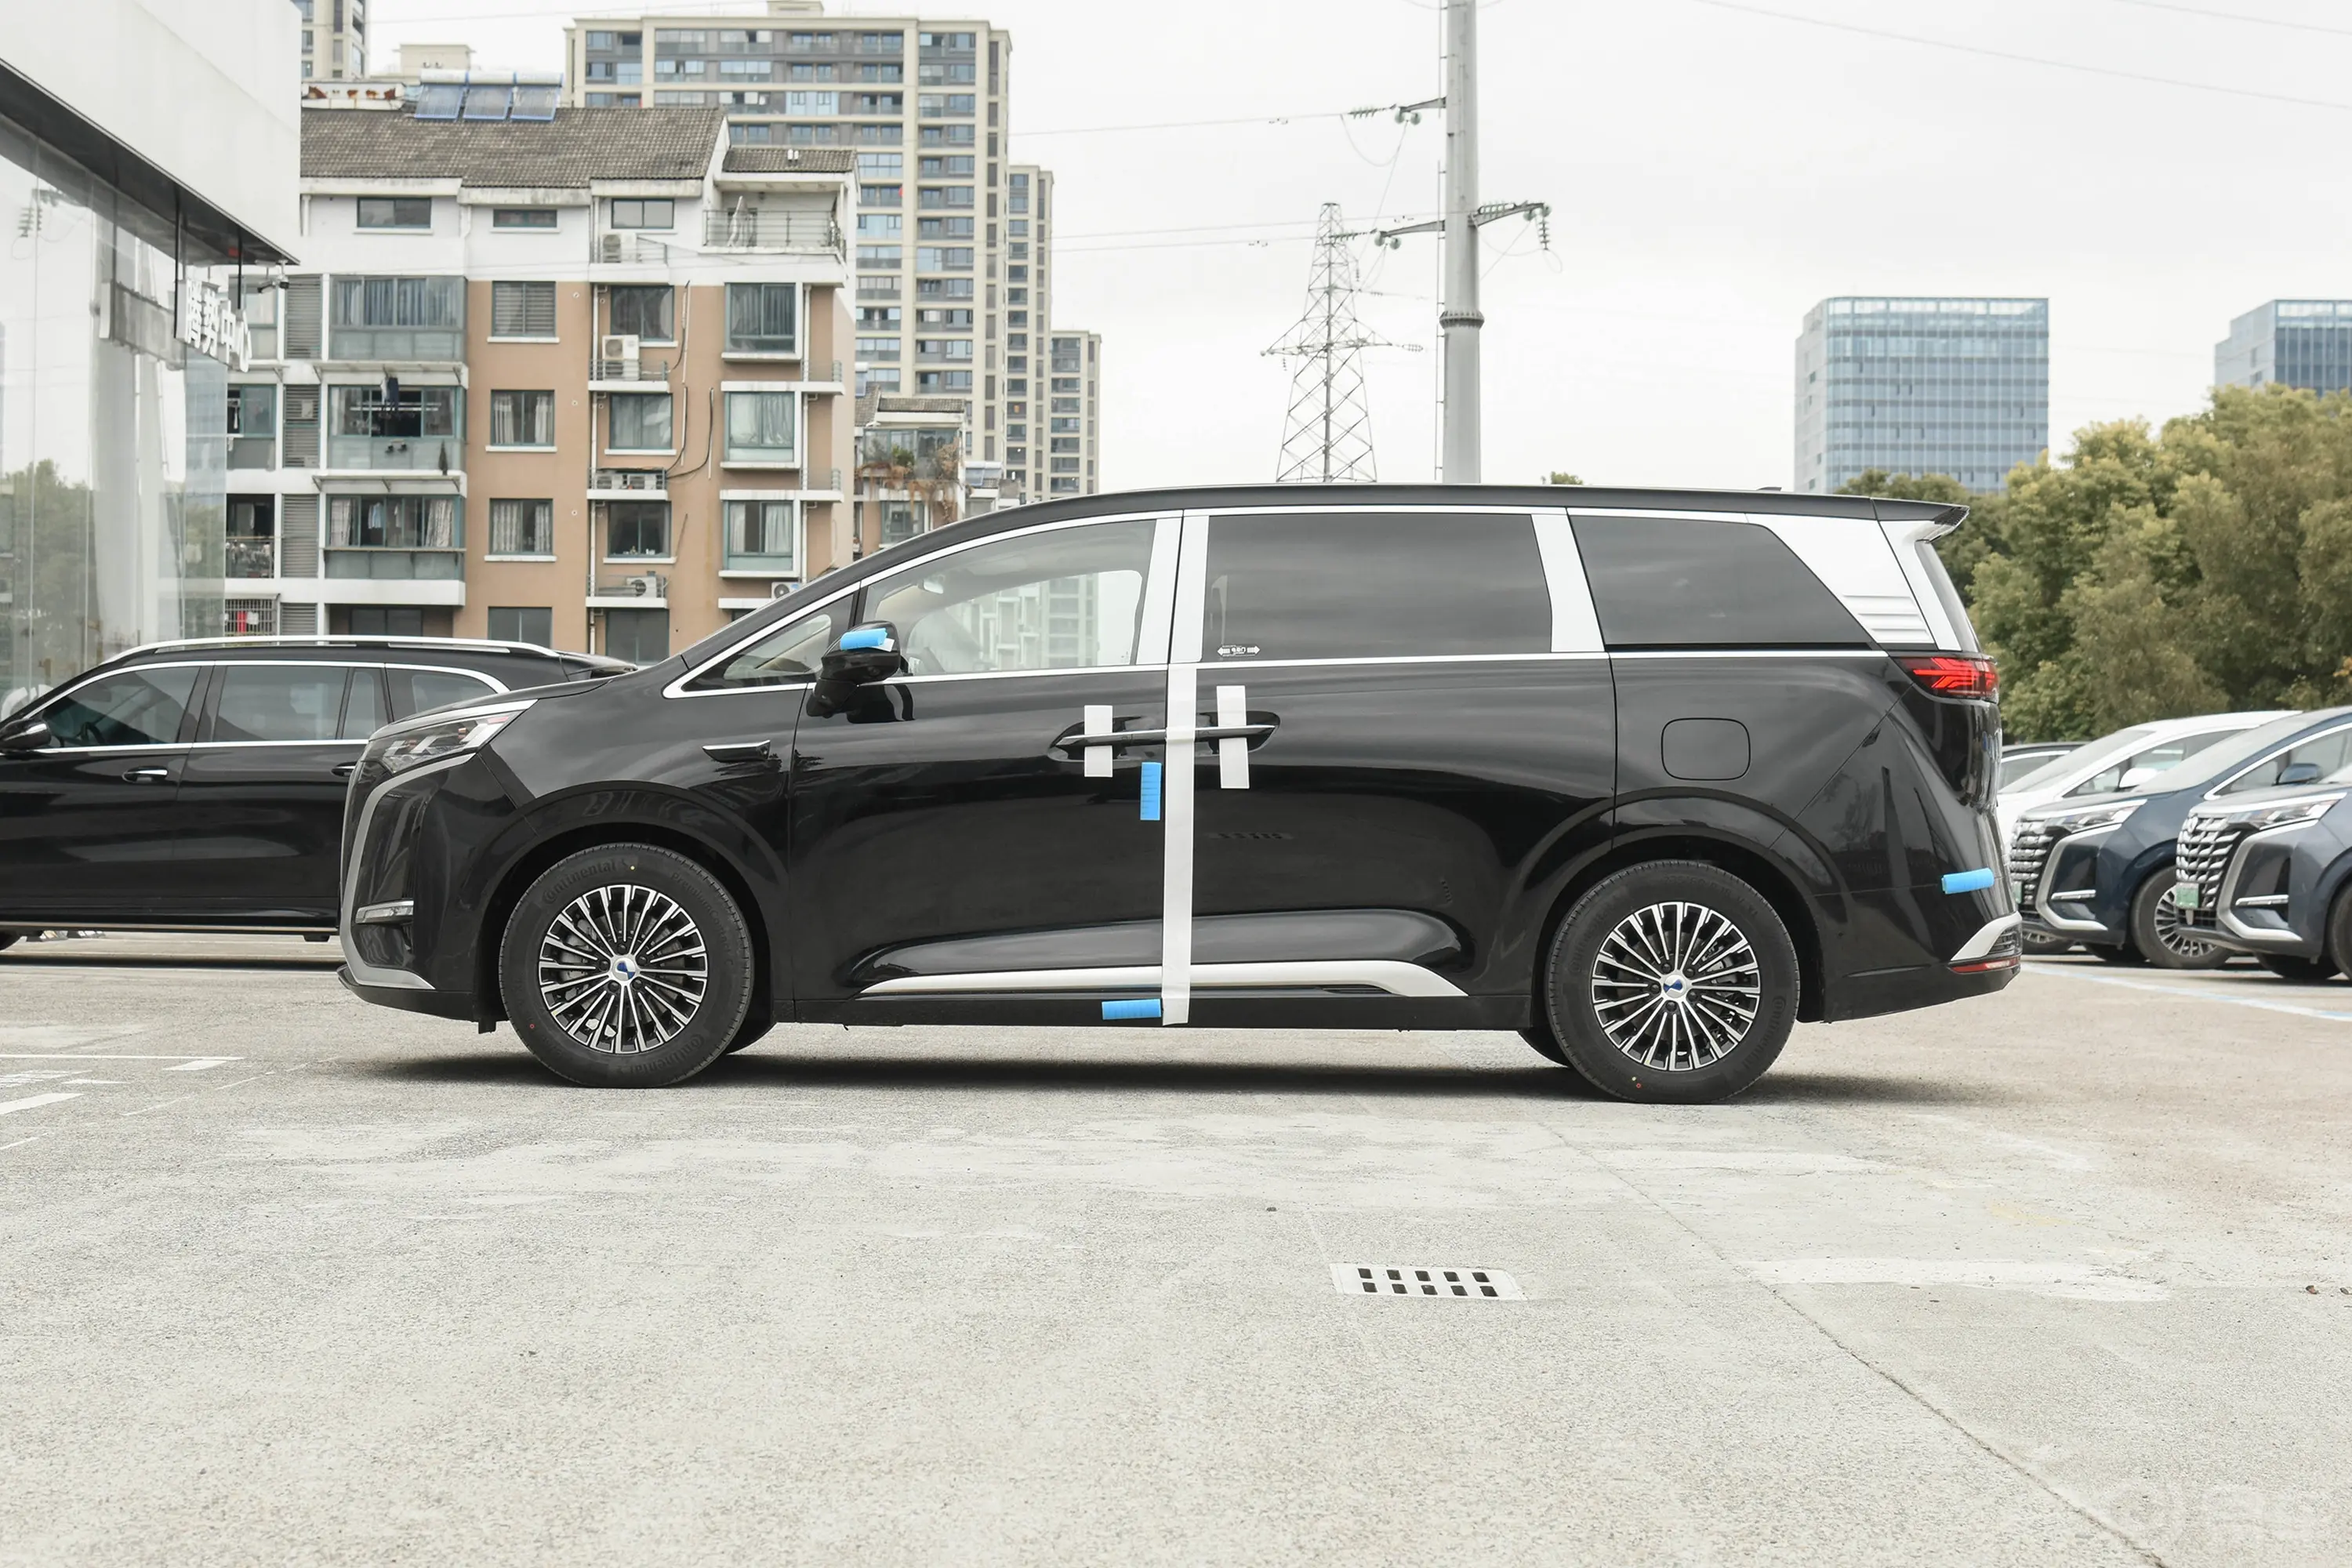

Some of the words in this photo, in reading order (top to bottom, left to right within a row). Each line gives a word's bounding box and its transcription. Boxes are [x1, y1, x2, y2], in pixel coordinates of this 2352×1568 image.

[184, 279, 252, 372] 腾势中心
[542, 858, 617, 903] Continental
